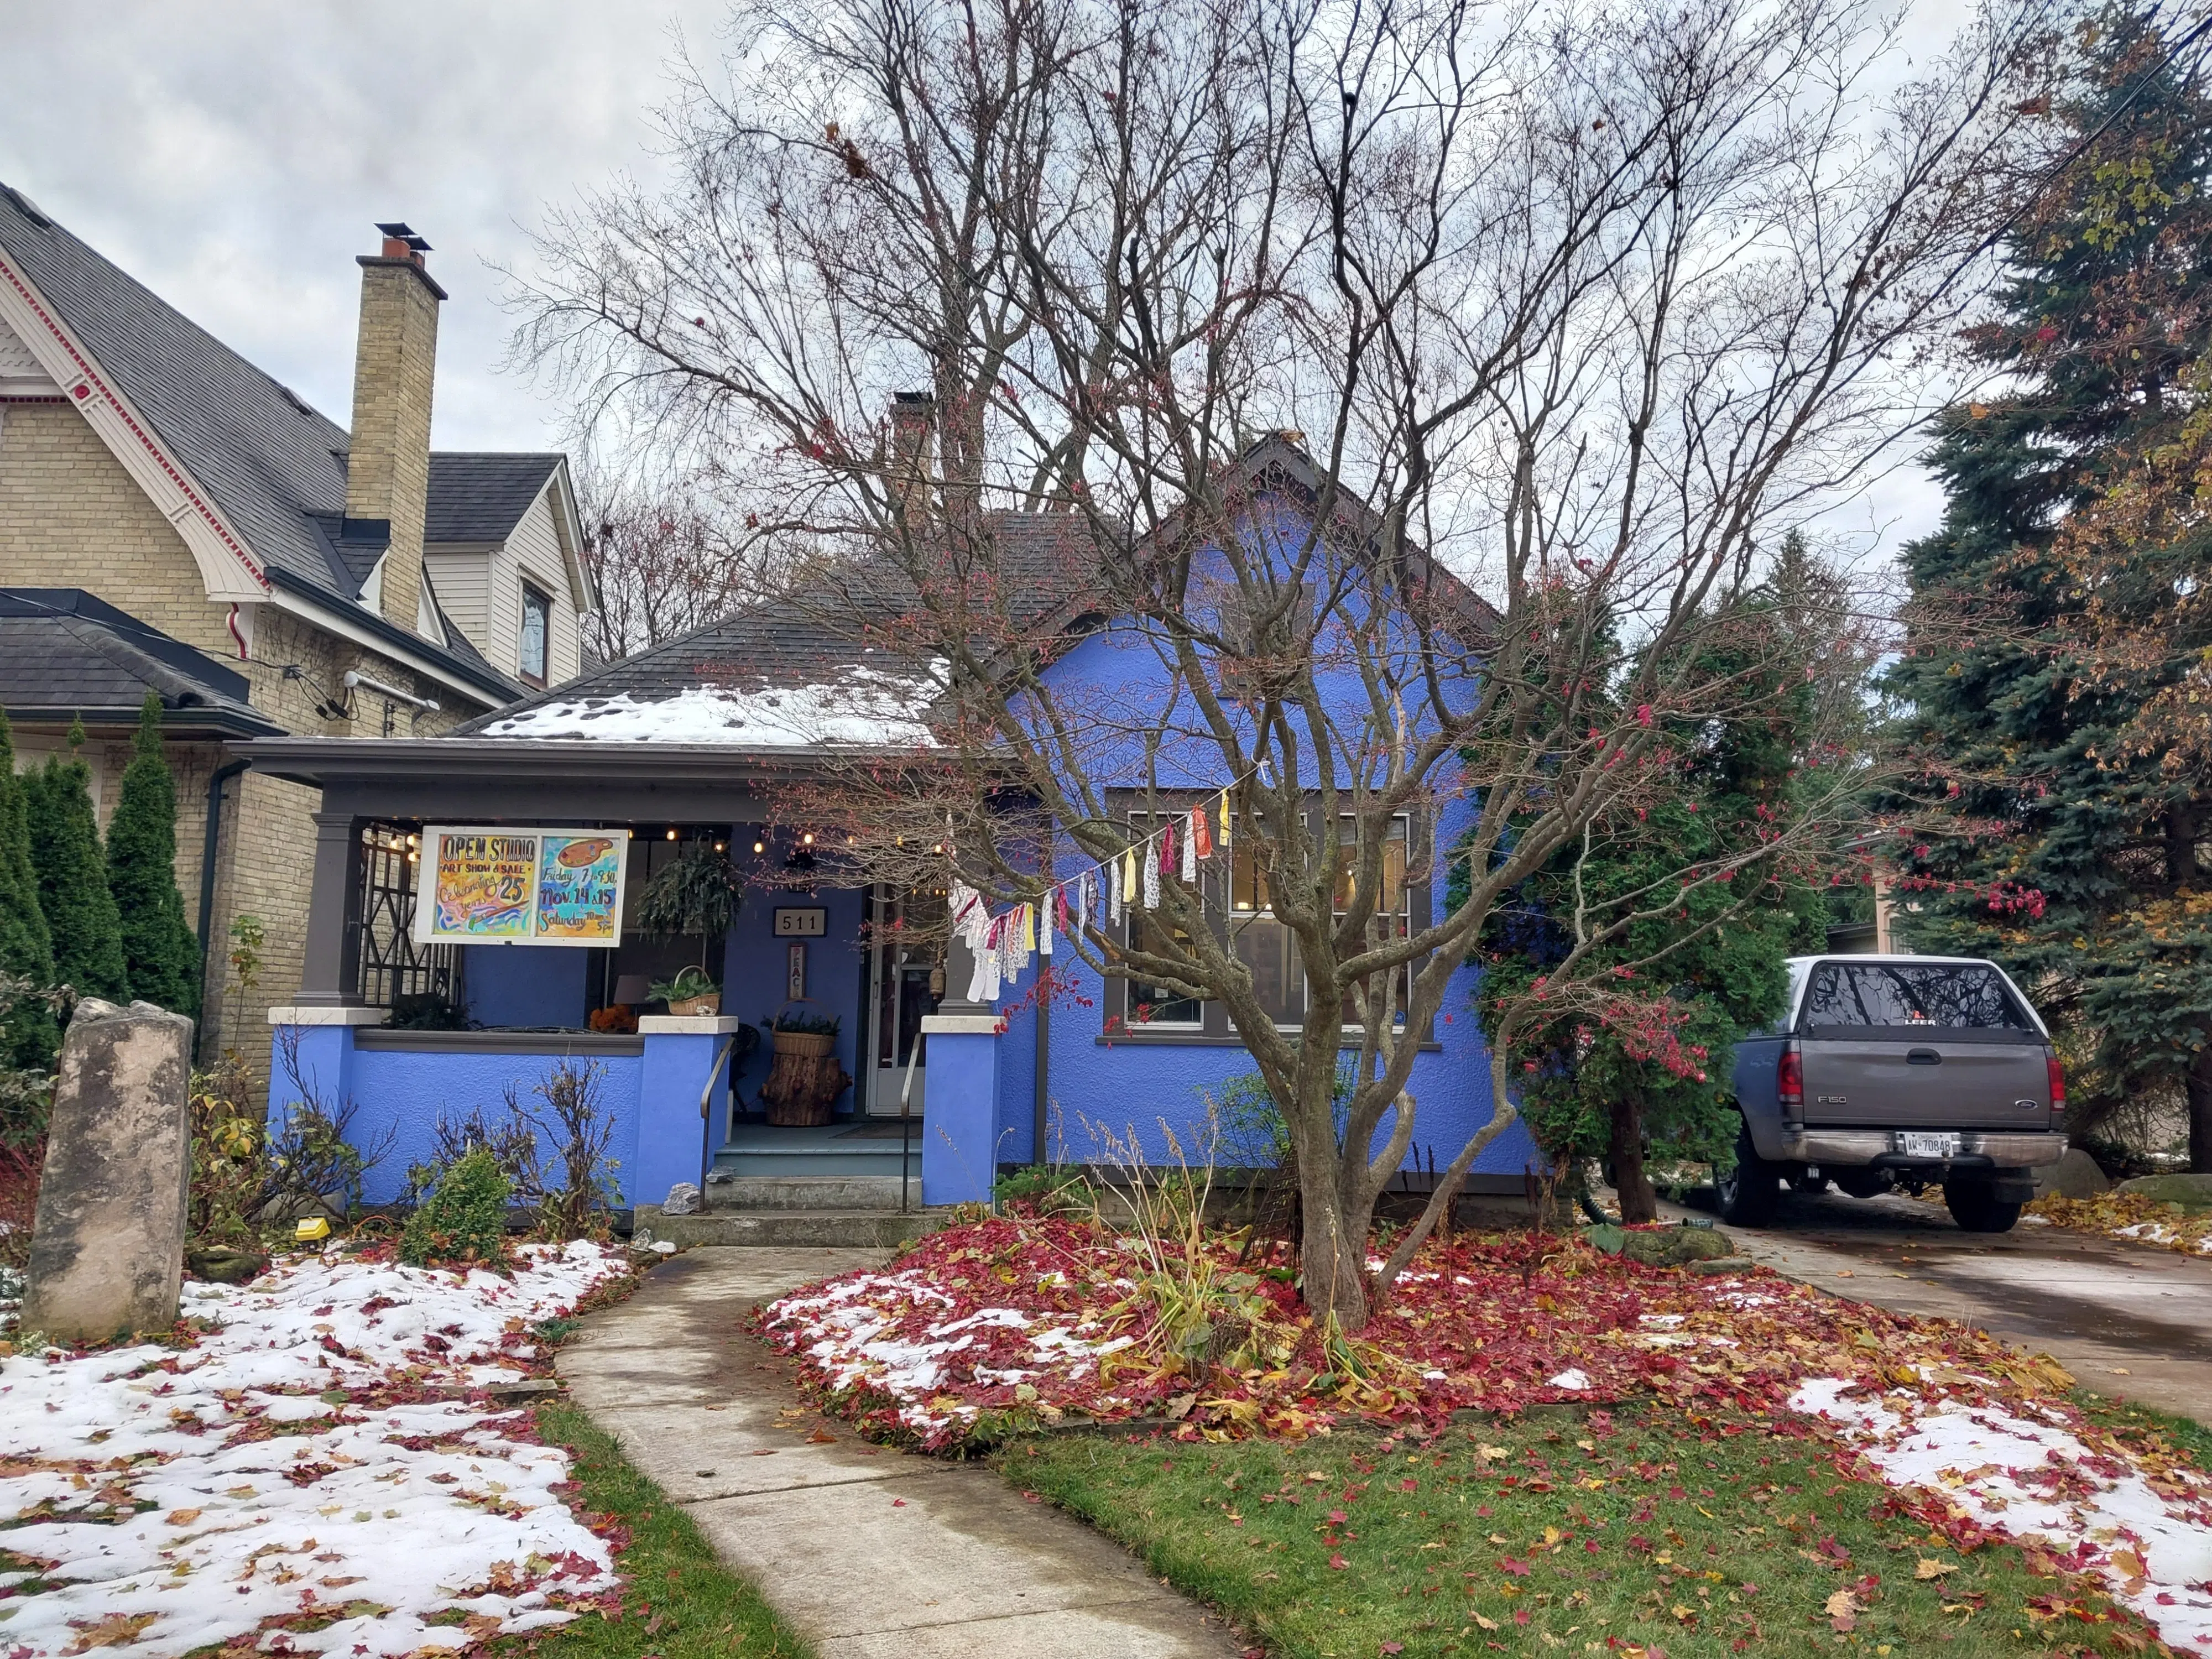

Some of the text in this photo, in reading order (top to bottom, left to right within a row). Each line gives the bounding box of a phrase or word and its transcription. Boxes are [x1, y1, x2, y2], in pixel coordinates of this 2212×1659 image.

[443, 837, 535, 862] OPEN STUDIO
[442, 863, 525, 874] ART SHOW & SALE
[541, 867, 576, 887] Friday
[581, 868, 589, 882] 7
[440, 875, 525, 902] Celebrating 25
[574, 888, 589, 904] 14
[597, 889, 612, 905] 15
[540, 911, 586, 932] Saturday
[783, 915, 816, 930] 511
[1922, 1140, 1950, 1151] 70848
